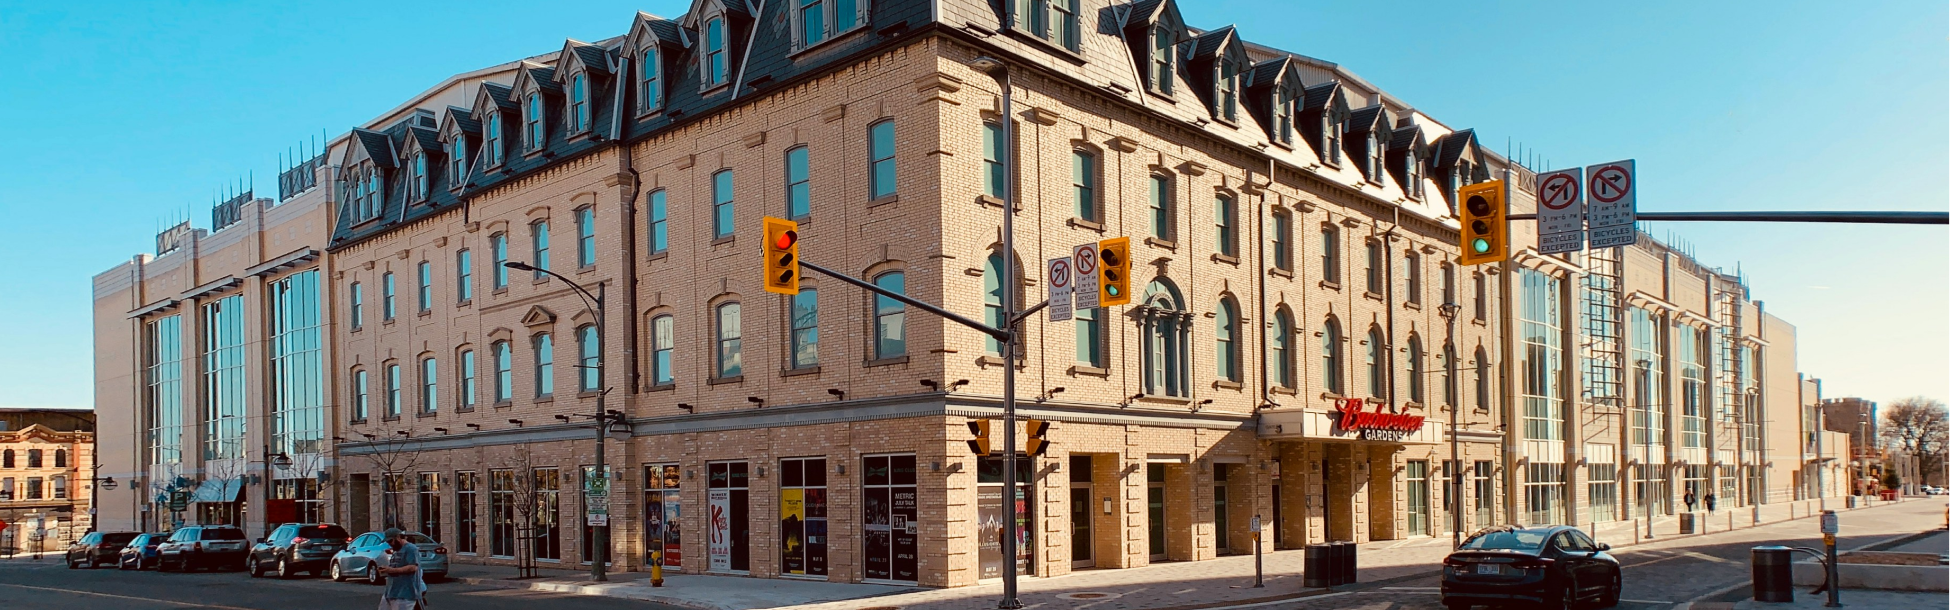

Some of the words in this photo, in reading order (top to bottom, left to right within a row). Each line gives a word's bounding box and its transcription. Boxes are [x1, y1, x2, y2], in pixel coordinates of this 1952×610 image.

[1543, 215, 1547, 223] 3
[1593, 227, 1630, 238] BICYCLES
[1543, 233, 1578, 244] BICYCLES
[1592, 236, 1632, 246] EXCEPTED
[1541, 242, 1580, 252] EXCEPTED
[1335, 398, 1425, 431] Budweiser
[1365, 429, 1404, 441] GARDENS
